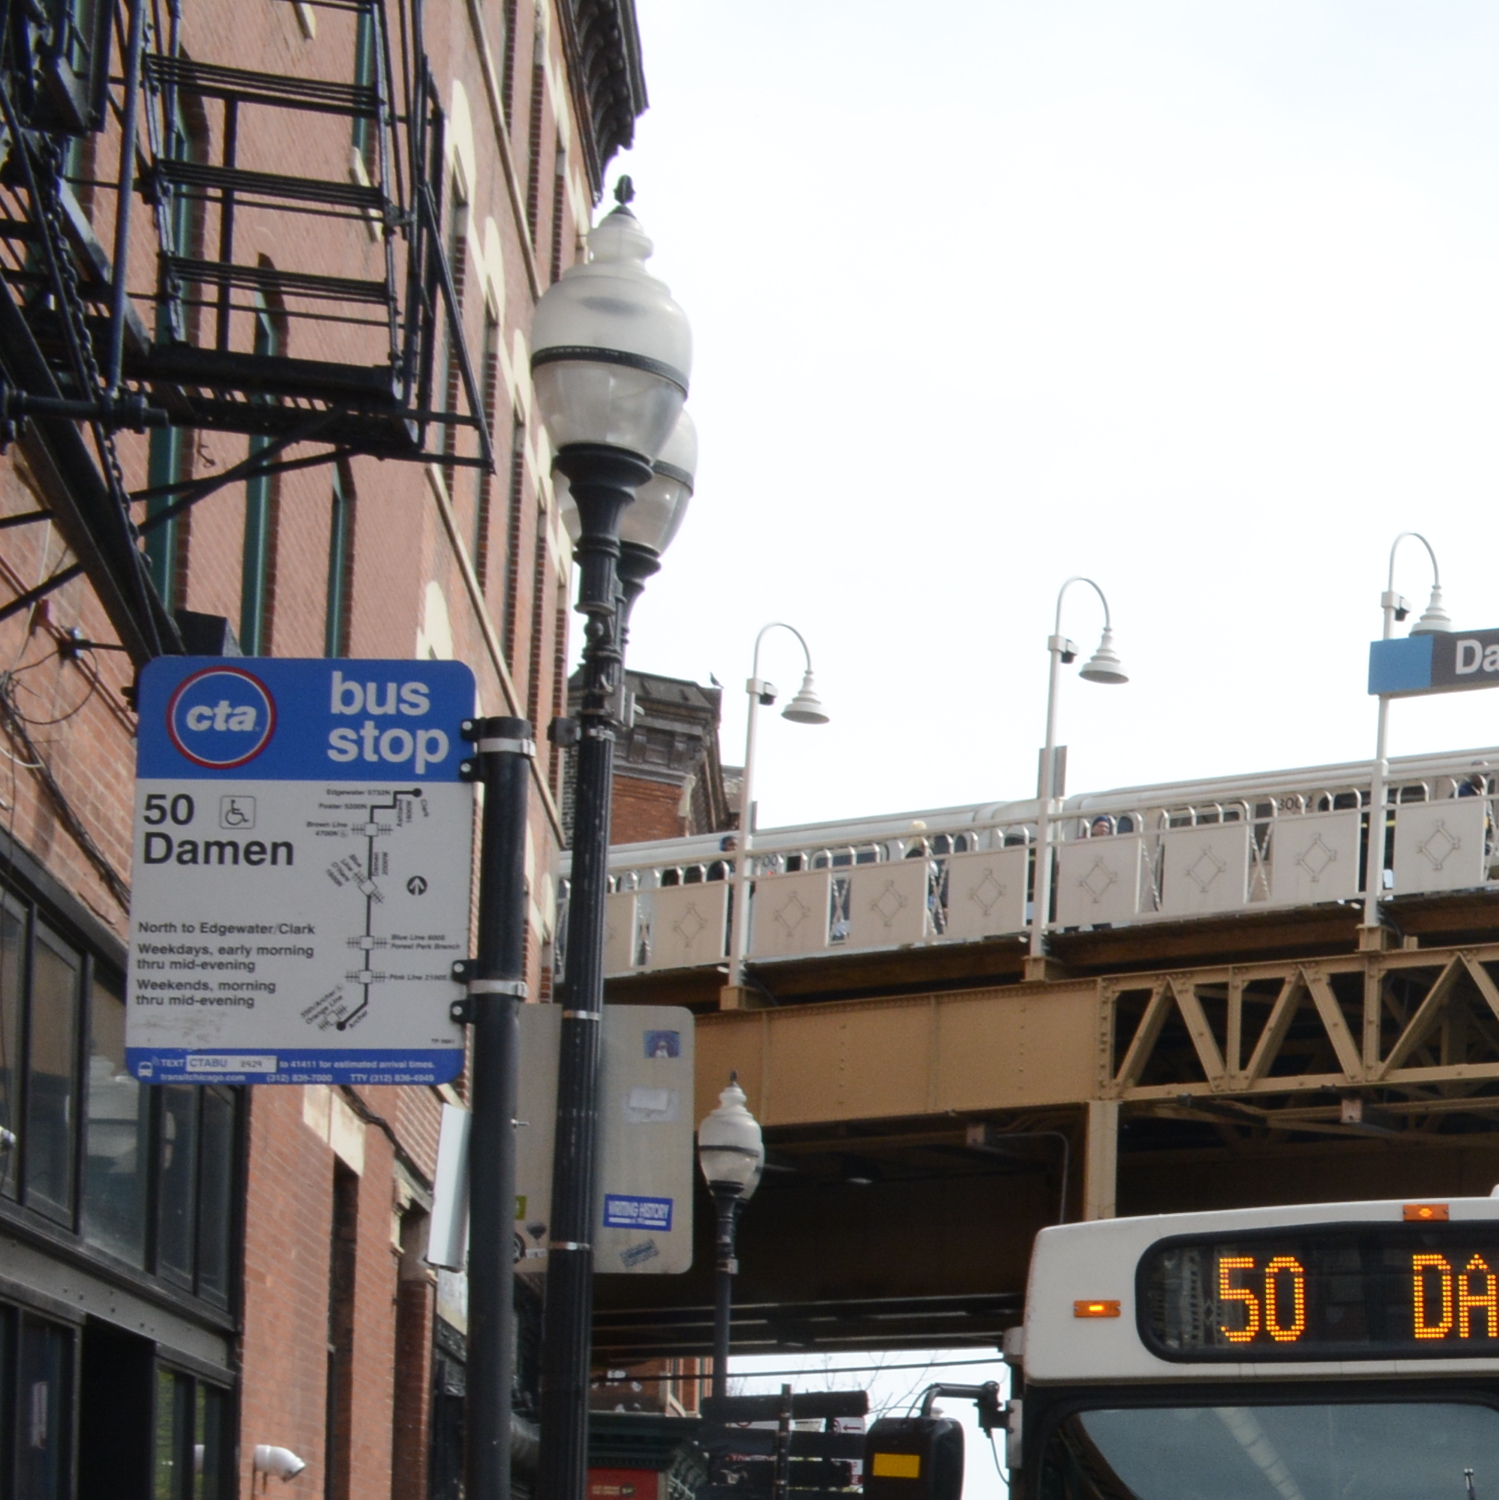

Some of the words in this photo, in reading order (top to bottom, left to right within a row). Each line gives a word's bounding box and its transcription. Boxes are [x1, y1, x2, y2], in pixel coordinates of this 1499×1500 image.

[330, 670, 430, 716] bus
[186, 700, 258, 732] cta
[327, 721, 449, 775] stop
[143, 794, 195, 826] 50
[143, 831, 294, 866] Damen
[139, 922, 177, 933] North
[182, 923, 195, 933] to
[200, 922, 316, 937] Edgewater/Clark
[138, 943, 214, 957] Weekdays,
[218, 944, 252, 957] early
[257, 945, 314, 958] morning
[137, 959, 165, 970] thru
[169, 960, 256, 973] mid-evening
[136, 979, 214, 992] Weekends,
[218, 981, 276, 994] morning
[136, 995, 164, 1006] thru
[169, 996, 255, 1009] mid-evening
[349, 1010, 368, 1030] Archer
[160, 1059, 185, 1067] TEXT
[189, 1058, 228, 1068] CTABU
[160, 1074, 246, 1083] transitchicago.com
[351, 1073, 368, 1081] TTY
[1220, 1255, 1306, 1343] 50
